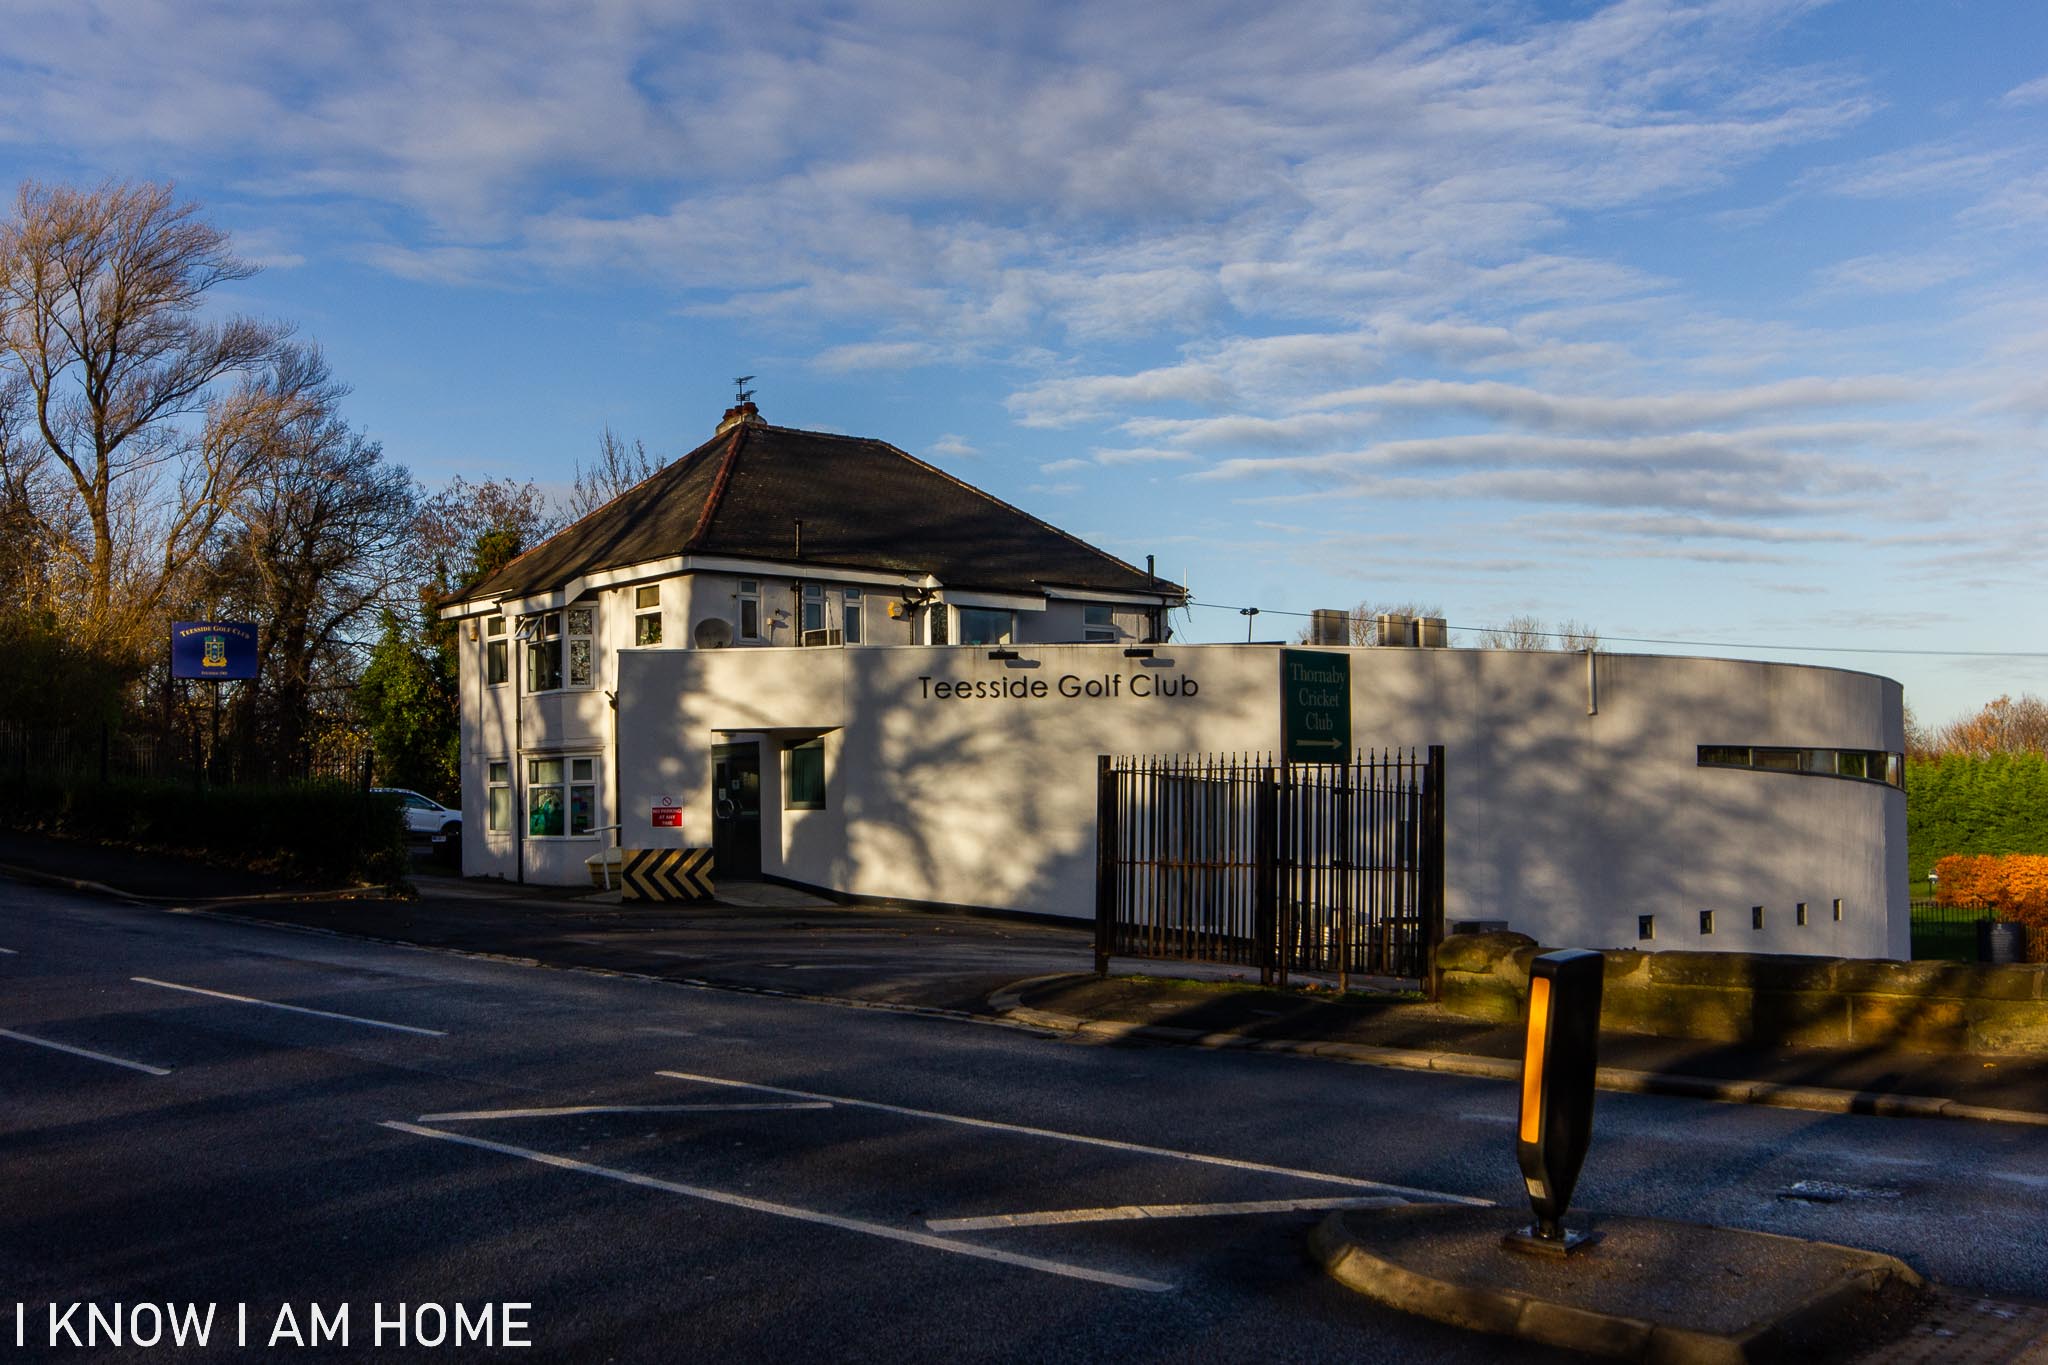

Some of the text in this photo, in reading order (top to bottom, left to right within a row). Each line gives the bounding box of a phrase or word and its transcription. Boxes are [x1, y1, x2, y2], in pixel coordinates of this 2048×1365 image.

[918, 673, 1199, 699] Teesside Golf Club
[1290, 663, 1345, 690] Thornaby
[1298, 688, 1340, 707] Cricket
[1305, 711, 1333, 730] Club
